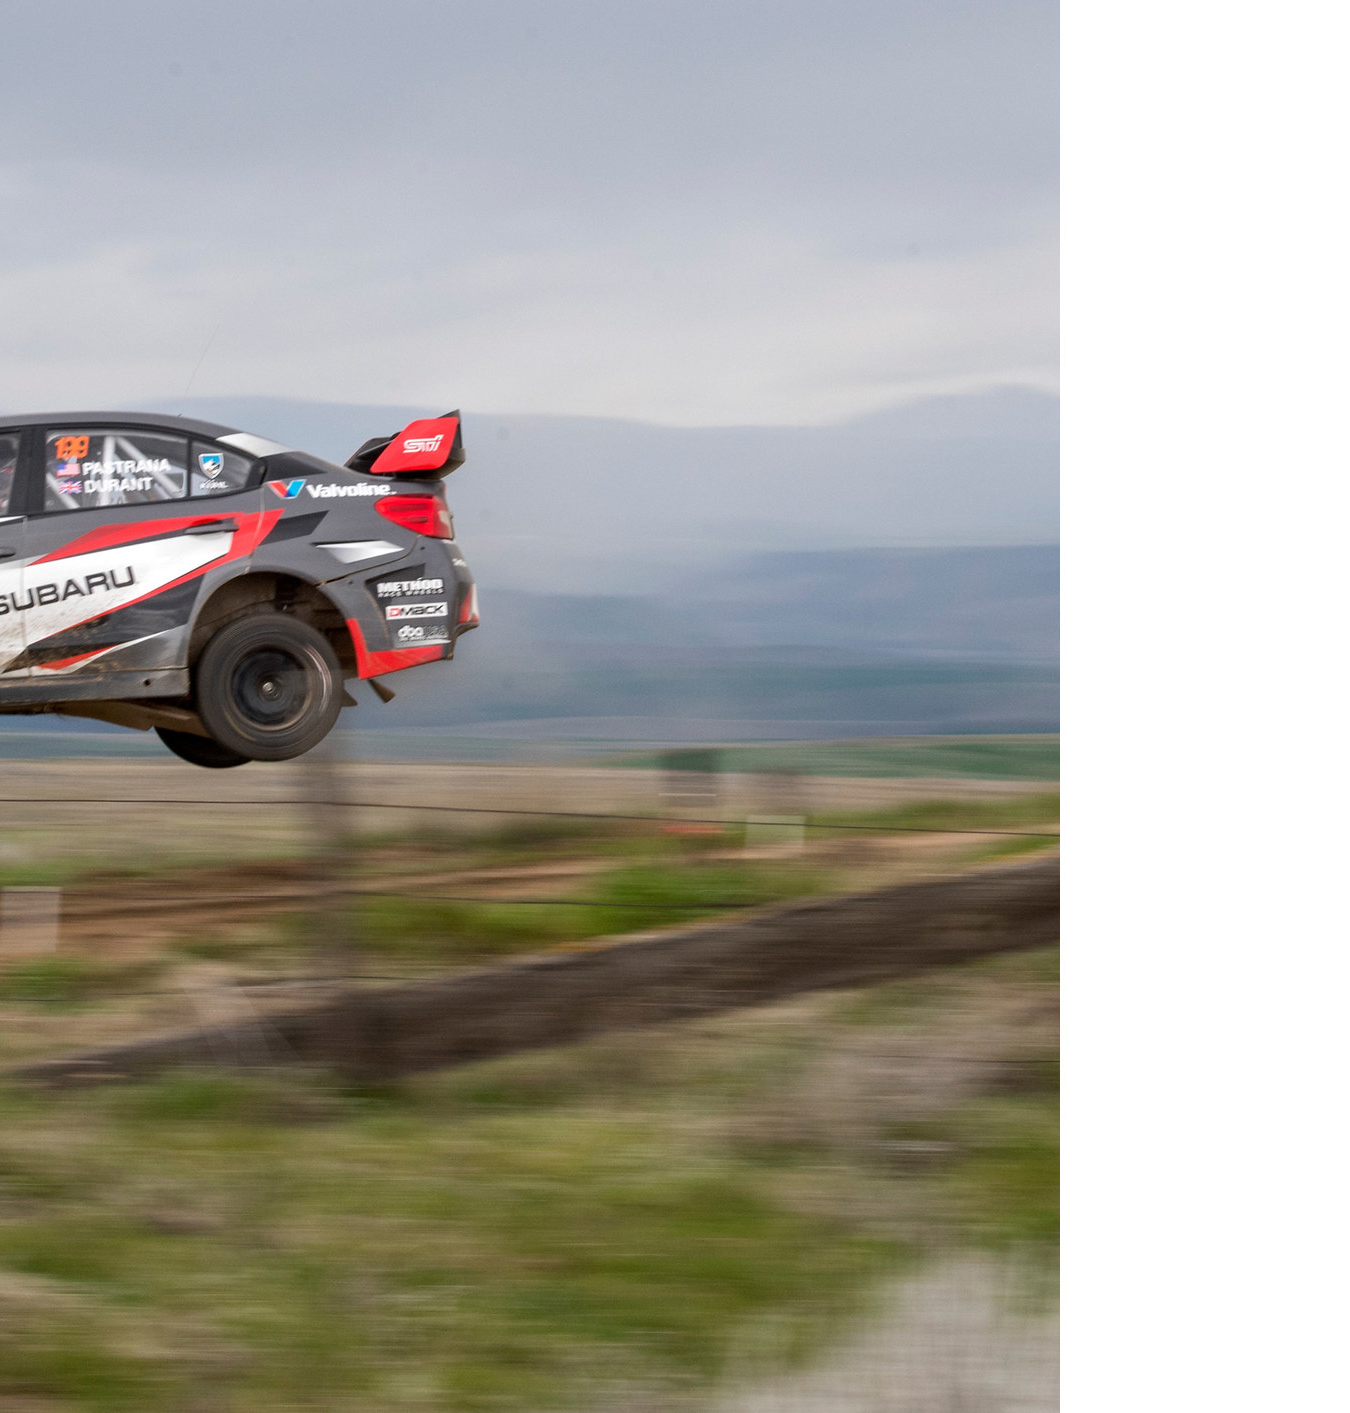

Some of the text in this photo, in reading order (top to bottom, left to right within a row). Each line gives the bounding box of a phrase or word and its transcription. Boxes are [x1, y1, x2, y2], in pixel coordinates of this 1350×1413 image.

[55, 436, 90, 459] 199
[82, 458, 172, 476] PASTRANA
[84, 477, 154, 493] DURANT
[377, 578, 444, 593] METHOD
